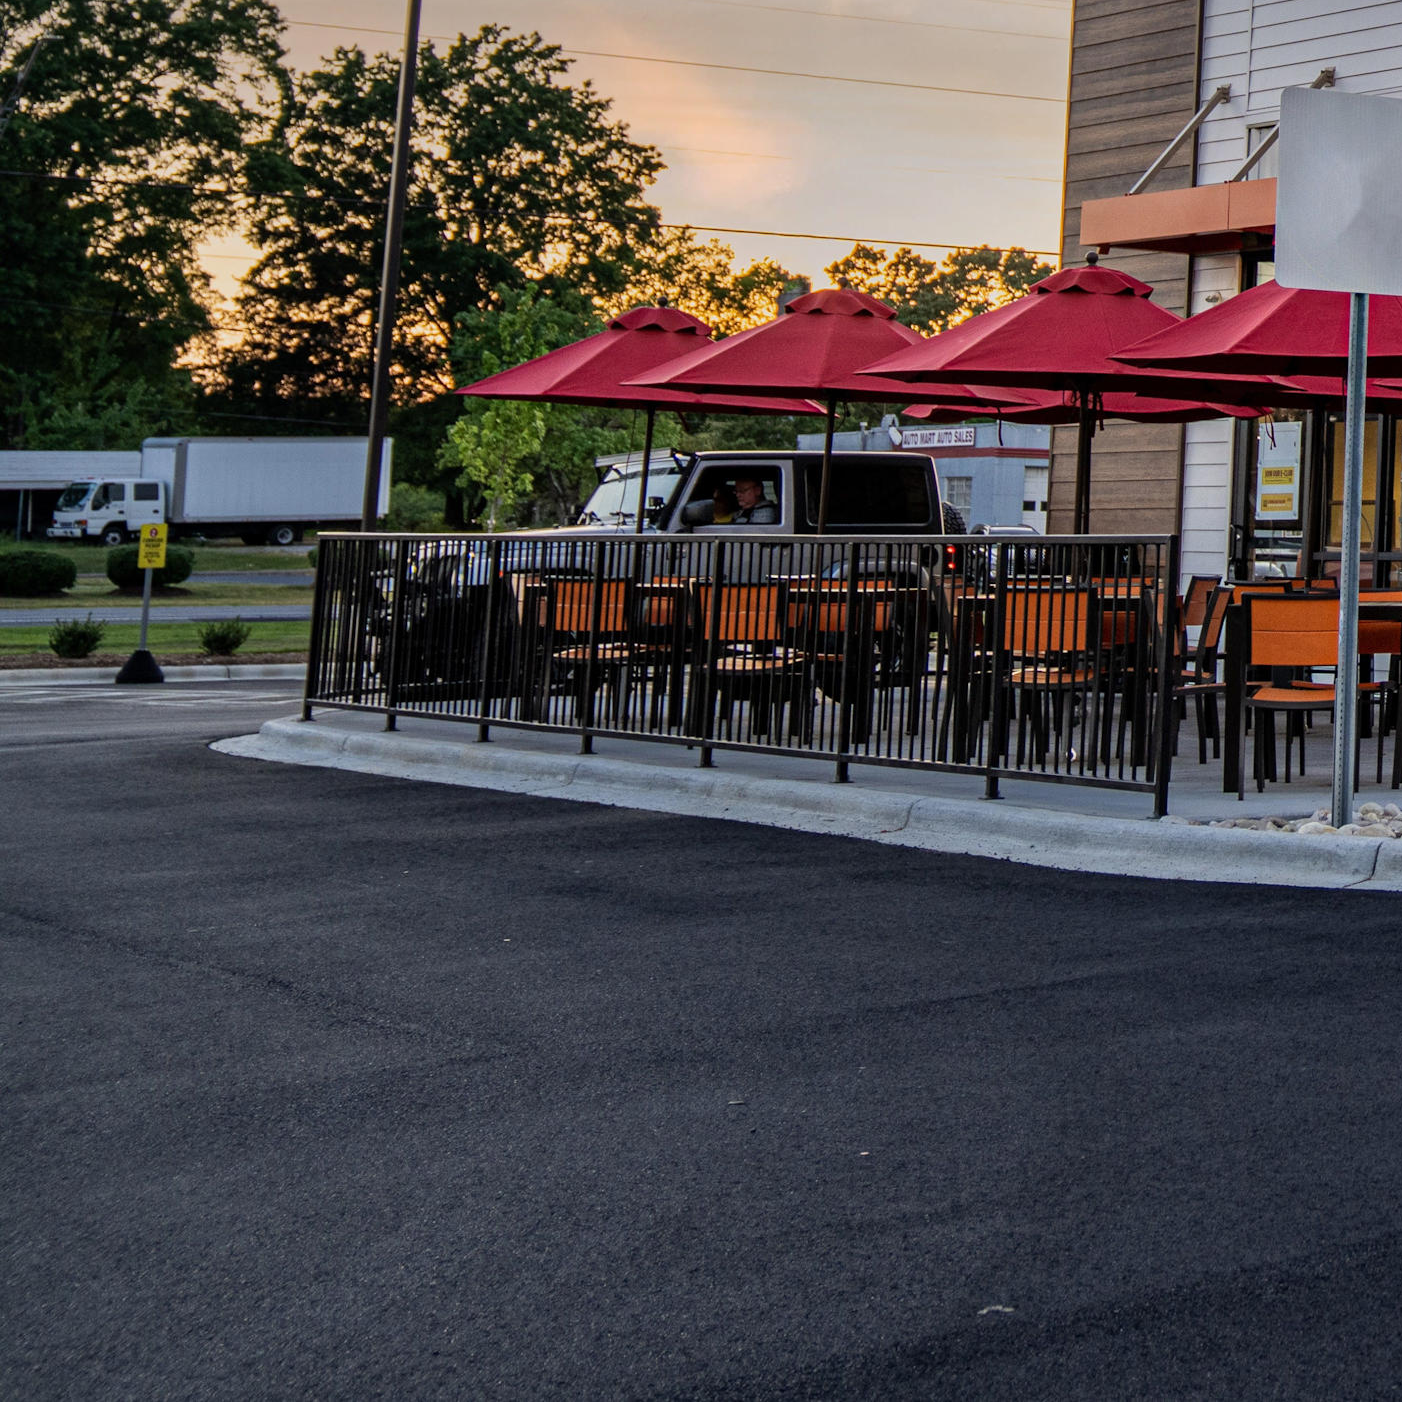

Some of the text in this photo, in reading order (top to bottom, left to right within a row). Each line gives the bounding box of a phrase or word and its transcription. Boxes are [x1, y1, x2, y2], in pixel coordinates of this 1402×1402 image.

[903, 430, 973, 446] AUTO MART AUTO SALES
